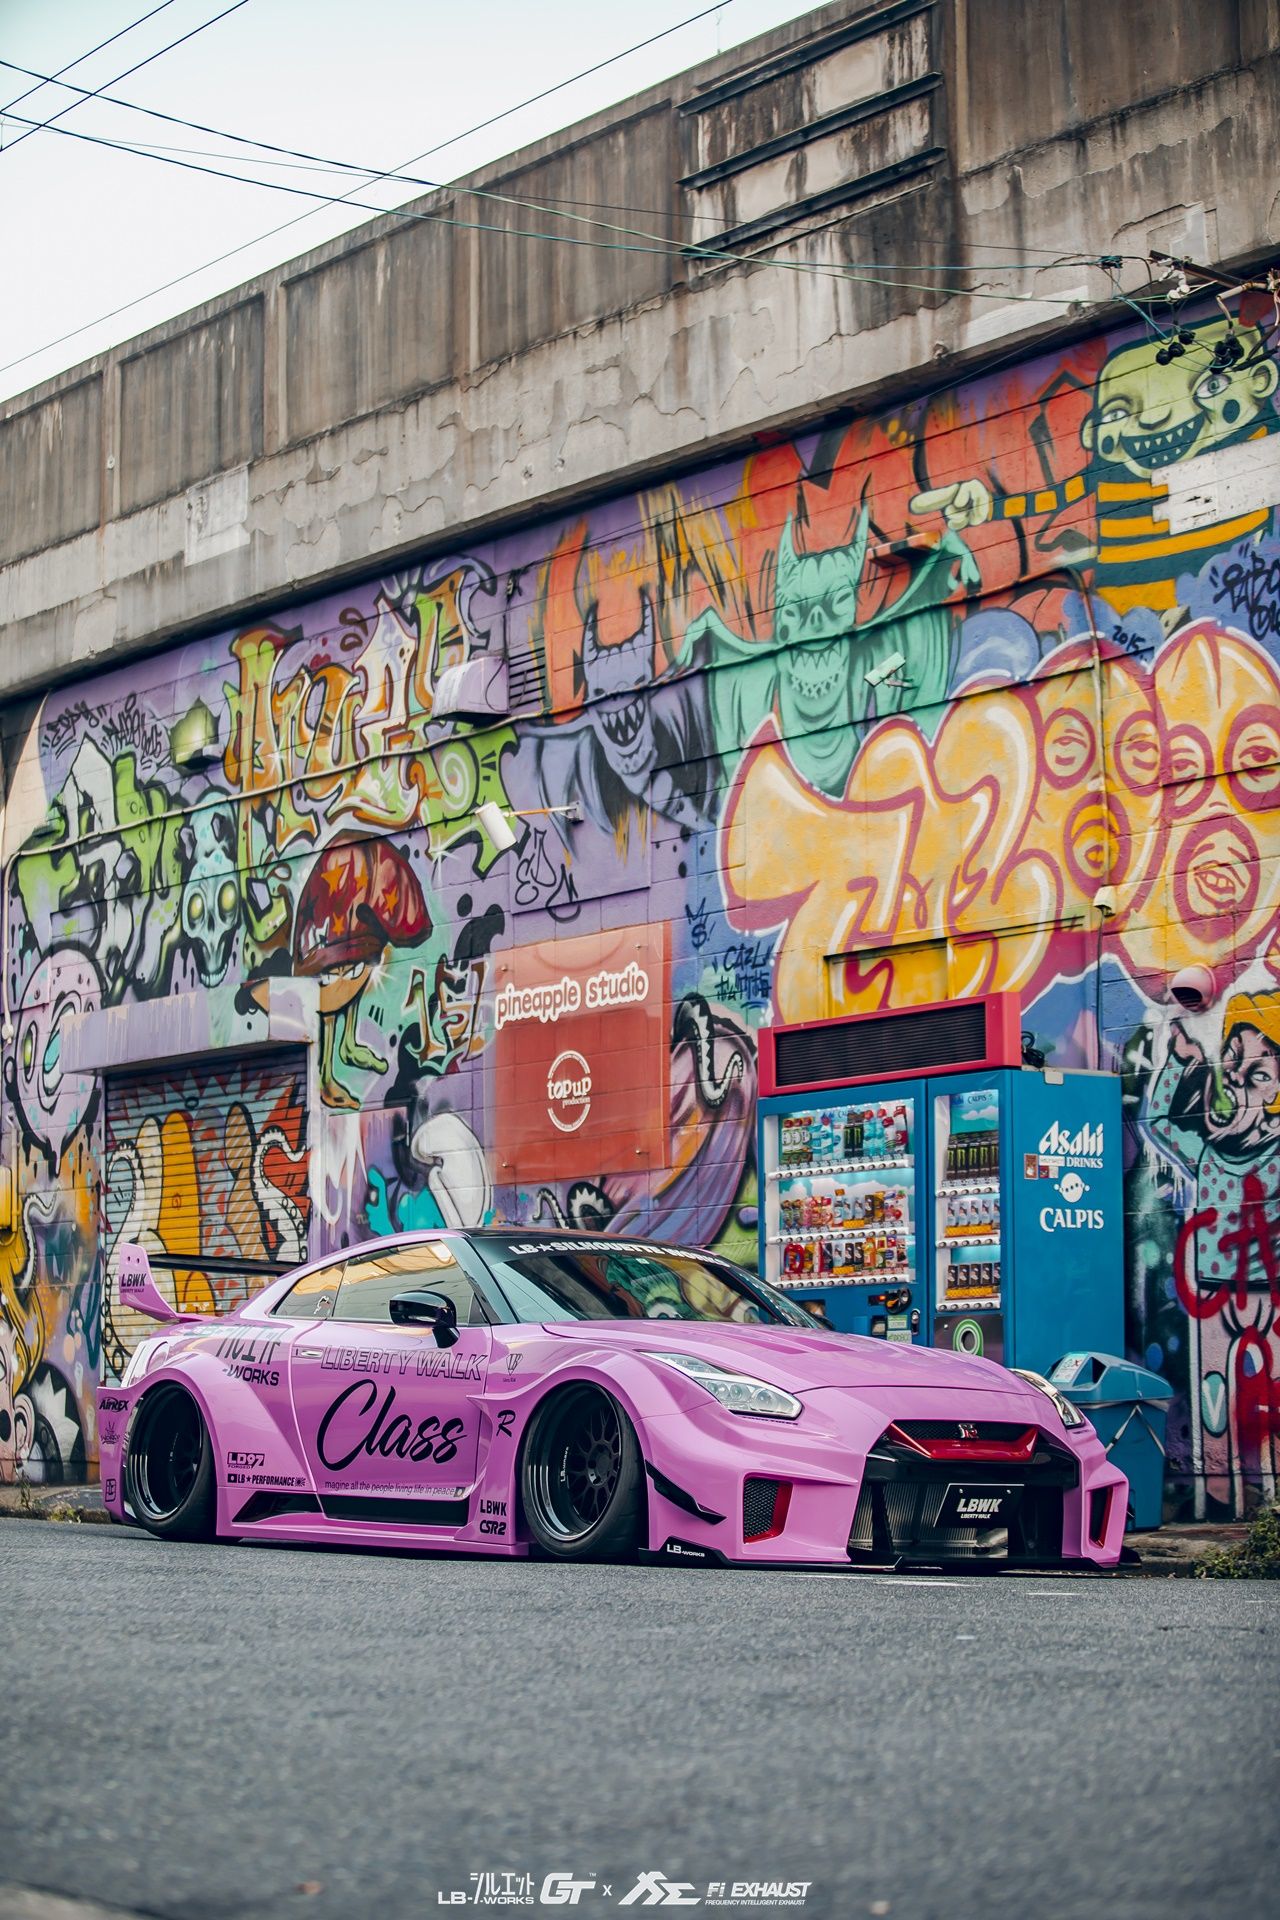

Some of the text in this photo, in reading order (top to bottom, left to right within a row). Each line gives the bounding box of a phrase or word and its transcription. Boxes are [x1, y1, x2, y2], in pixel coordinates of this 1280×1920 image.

[495, 962, 649, 1030] pineapple studio
[1038, 1120, 1104, 1156] Asahi
[1066, 1156, 1104, 1168] DRINKS
[1039, 1207, 1104, 1232] CALPIS
[120, 1273, 147, 1287] LBWK
[321, 1345, 488, 1381] LIBERTY WALK
[317, 1378, 467, 1471] Class
[496, 1409, 516, 1438] R
[252, 1475, 295, 1486] PERFORMANCE
[351, 1480, 359, 1490] all
[359, 1481, 370, 1490] the
[371, 1481, 394, 1493] people
[432, 1486, 455, 1496] peace
[480, 1499, 507, 1517] LBWK
[957, 1498, 1002, 1512] LBWK
[479, 1519, 507, 1535] CSR2
